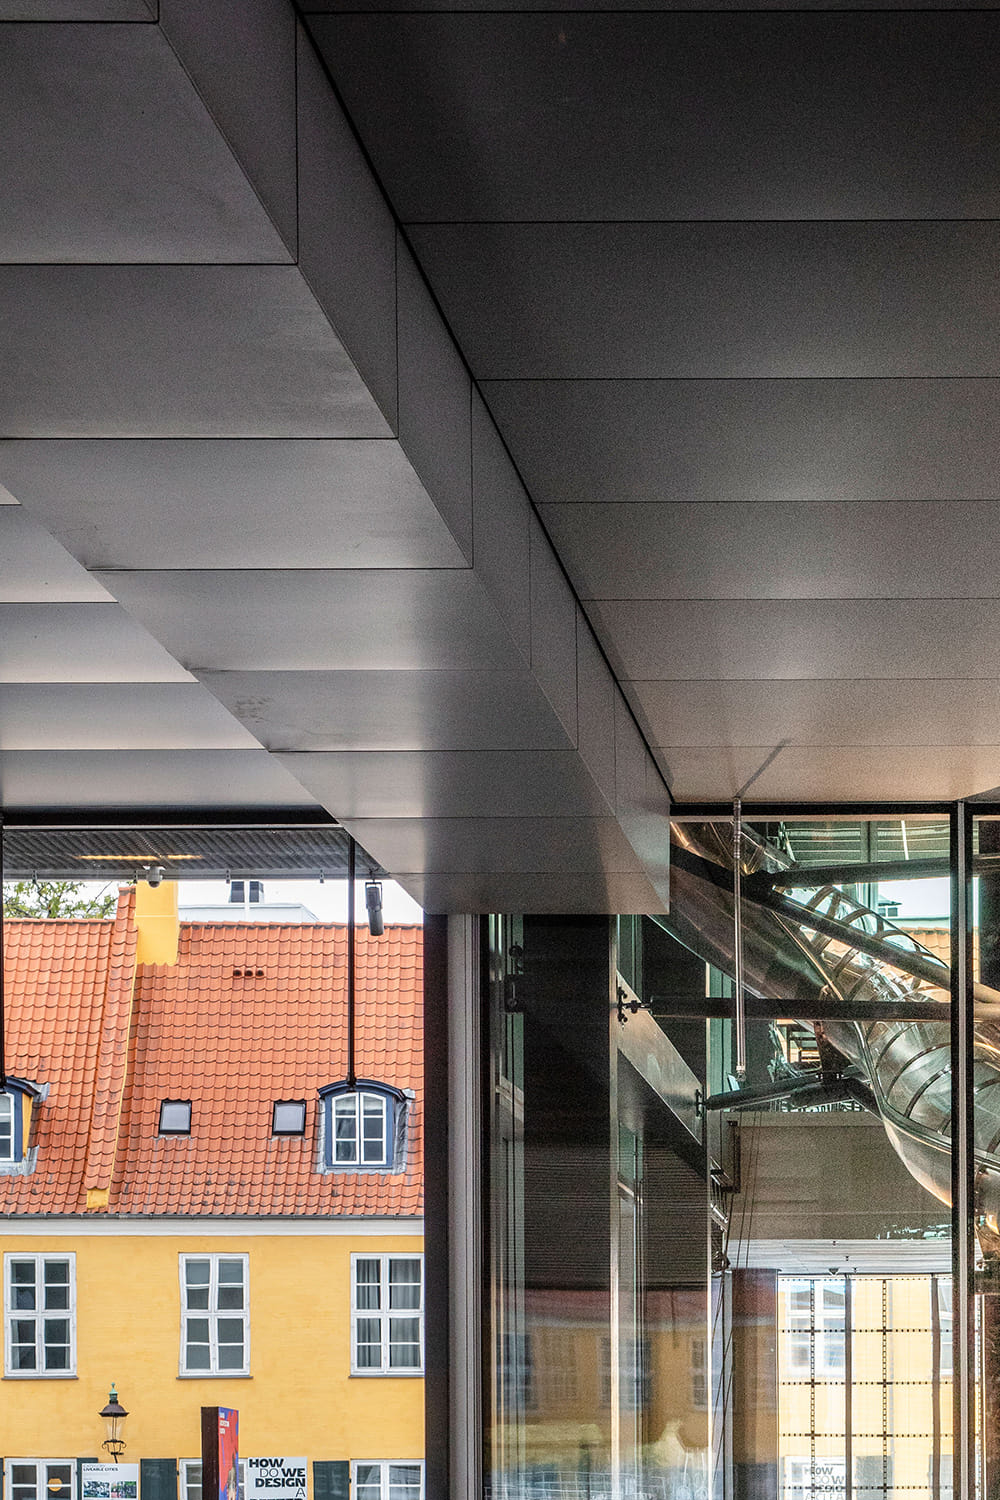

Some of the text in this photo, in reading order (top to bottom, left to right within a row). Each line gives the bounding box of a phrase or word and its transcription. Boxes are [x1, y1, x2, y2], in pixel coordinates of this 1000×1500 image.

[249, 1458, 284, 1468] HOW
[260, 1468, 306, 1478] DO WE
[255, 1478, 306, 1488] DESIGN
[295, 1487, 306, 1498] A
